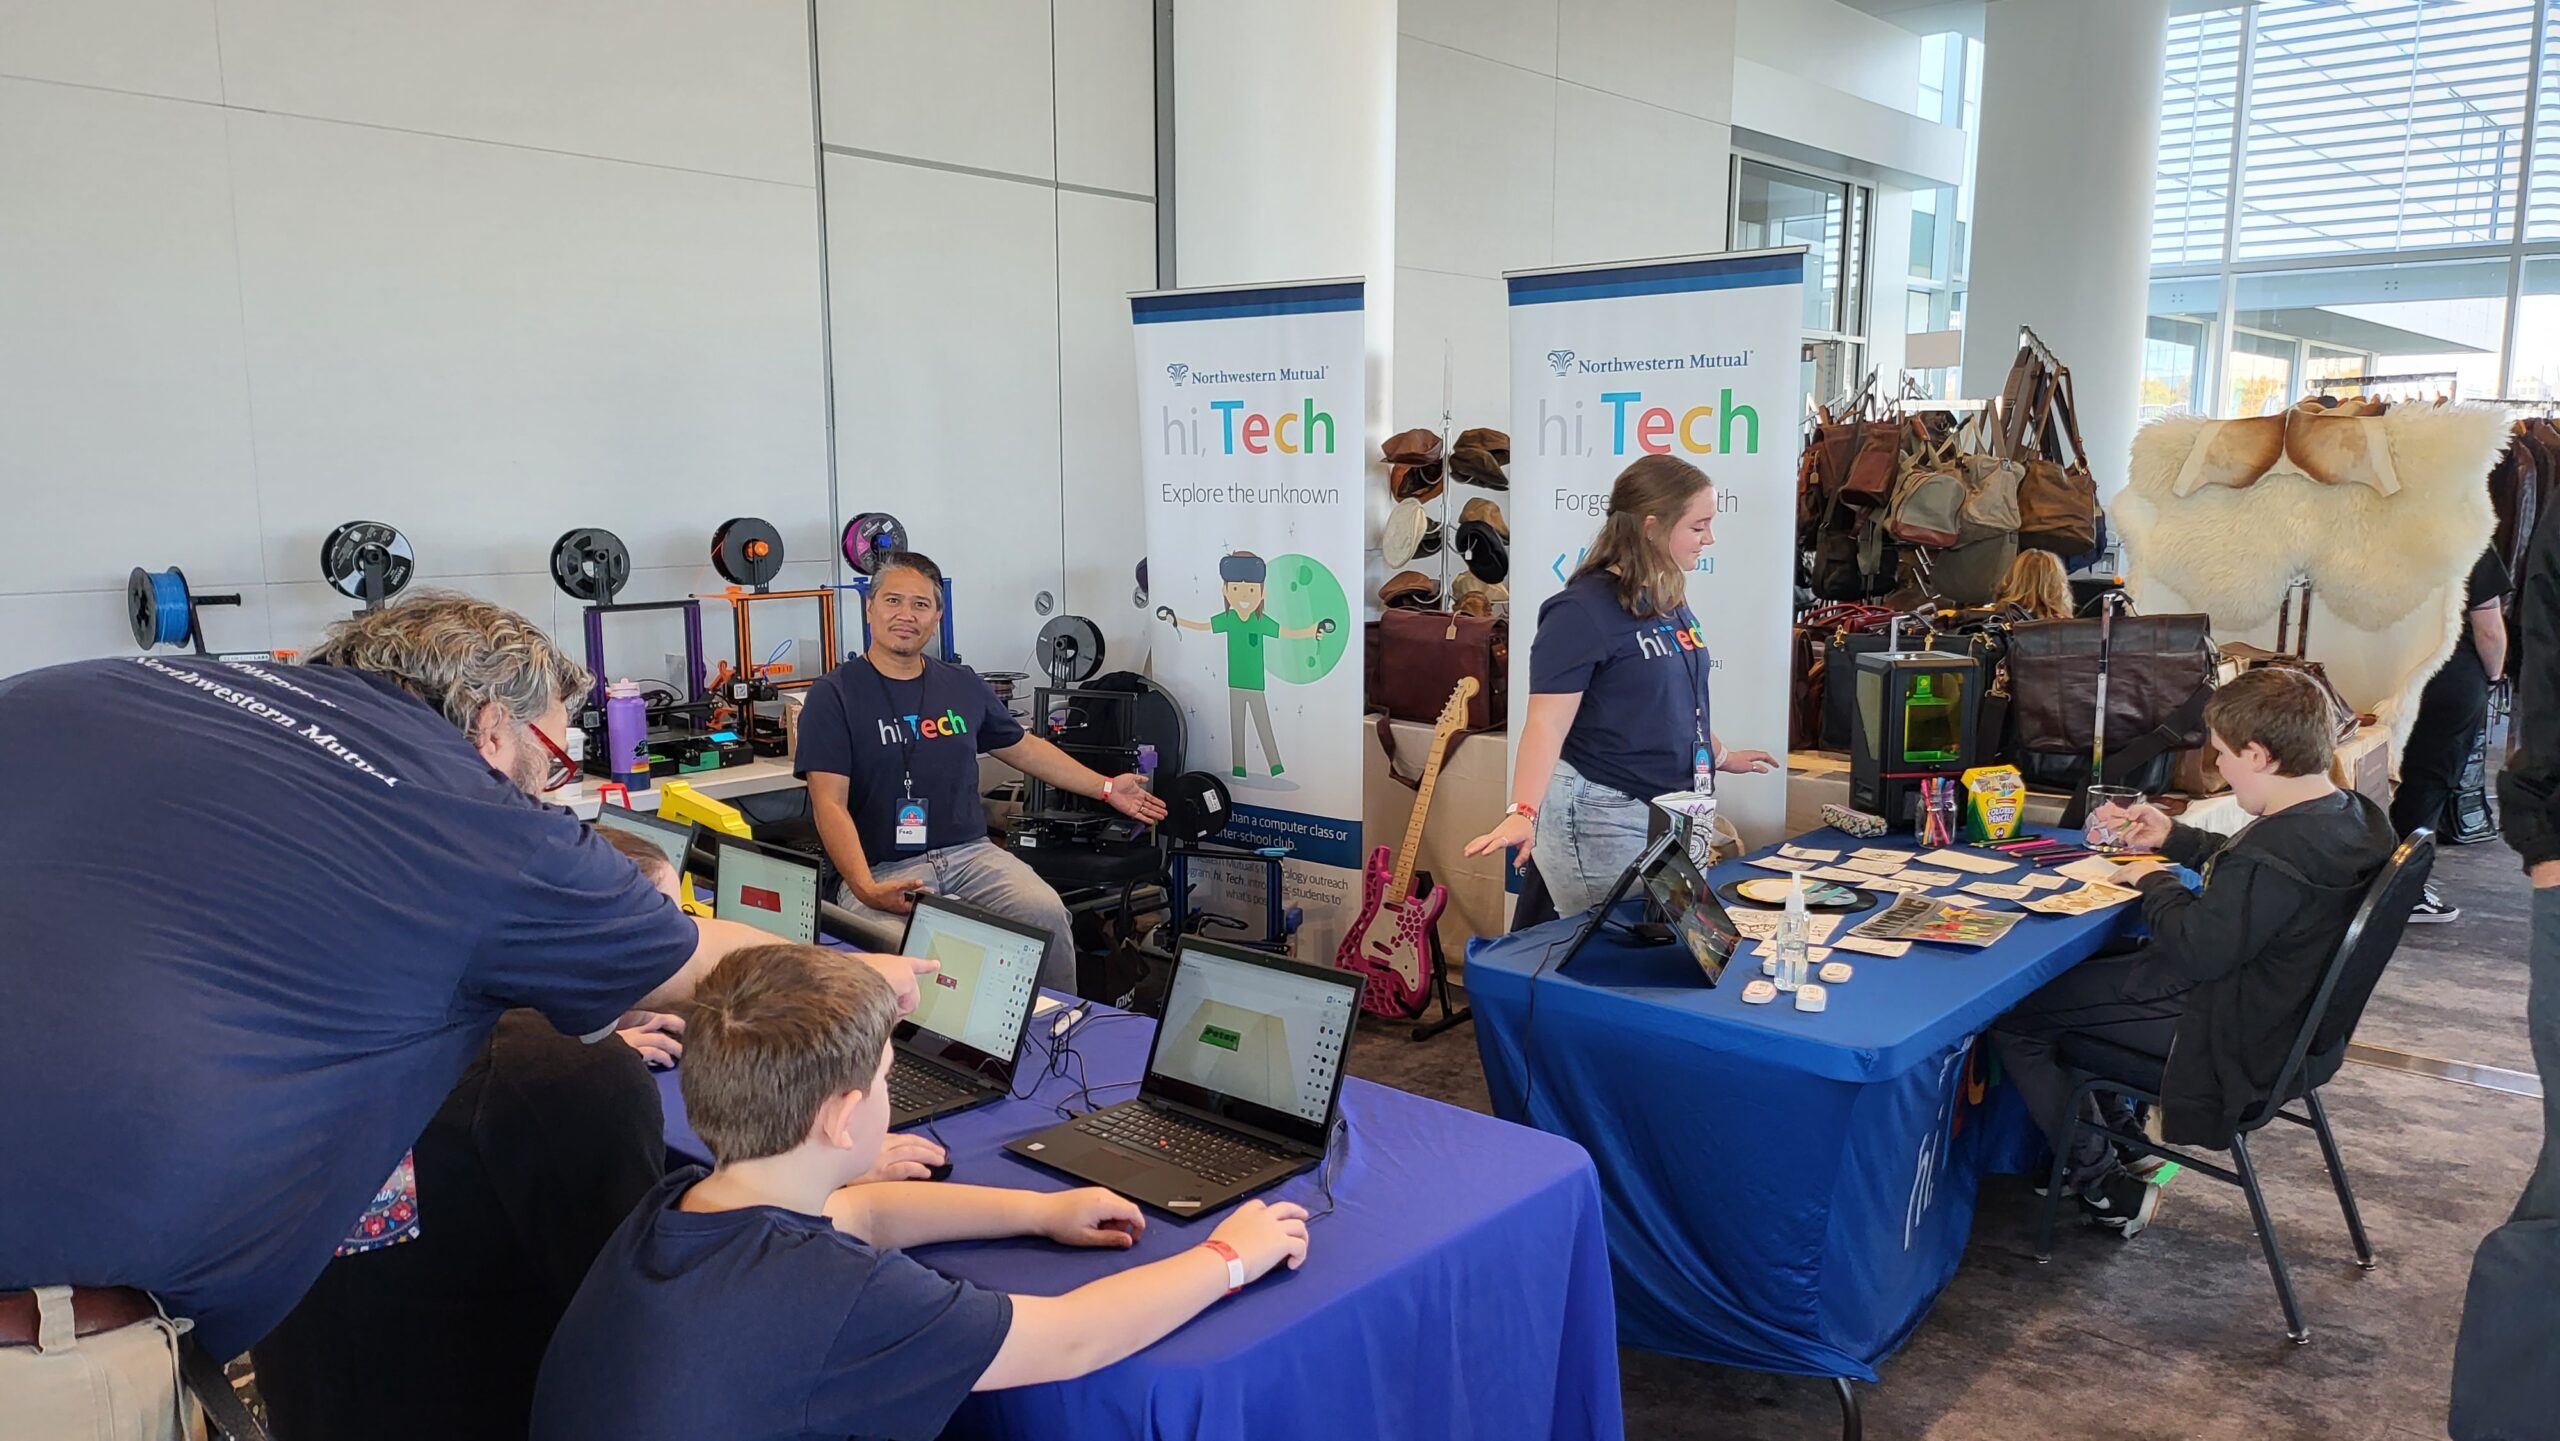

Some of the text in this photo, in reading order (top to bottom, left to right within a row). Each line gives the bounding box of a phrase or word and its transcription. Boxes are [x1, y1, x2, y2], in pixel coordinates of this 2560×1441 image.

[1578, 351, 1748, 374] Northwestern Mutual
[1191, 366, 1325, 385] Northwestern Mutual
[1163, 398, 1335, 457] hi, Tech
[1538, 388, 1759, 458] hi, Tech
[1162, 482, 1339, 507] Explore the unknown
[1554, 488, 1611, 516] Forge
[878, 709, 968, 745] hi, Tech
[1987, 806, 2016, 818] COLORED
[1988, 814, 2013, 825] PENCILS
[1229, 809, 1349, 842] han a computer class or
[1273, 837, 1298, 851] club.
[1309, 874, 1349, 891] outreach
[1292, 887, 1330, 904] students
[1331, 894, 1342, 906] to
